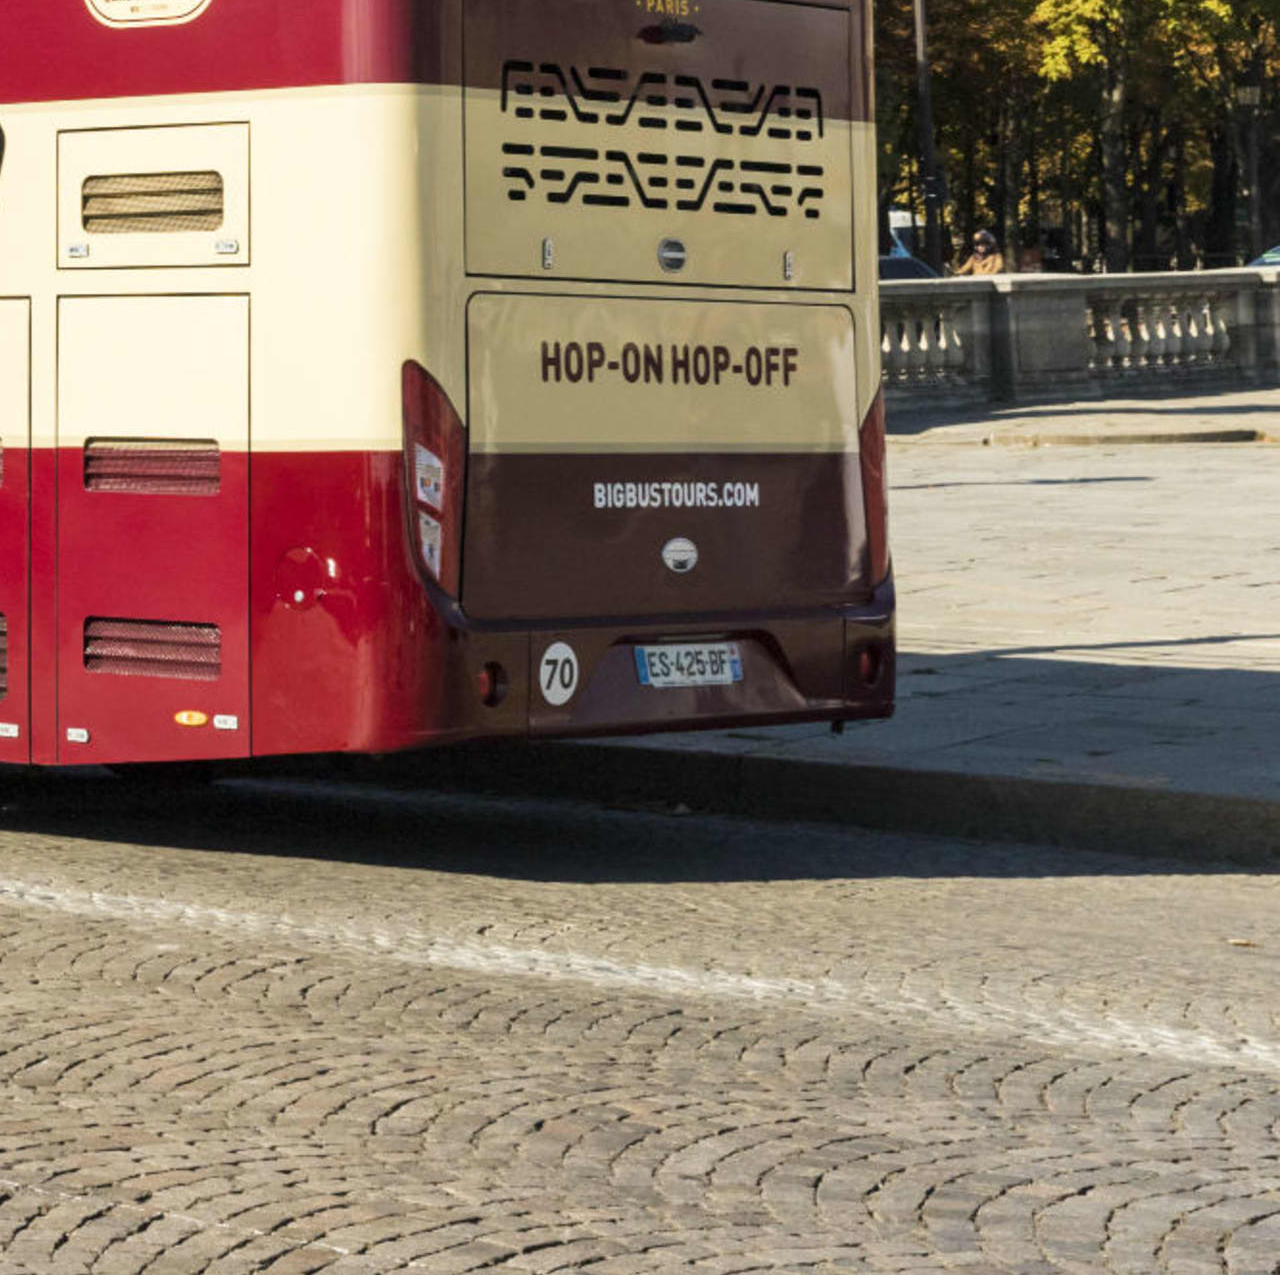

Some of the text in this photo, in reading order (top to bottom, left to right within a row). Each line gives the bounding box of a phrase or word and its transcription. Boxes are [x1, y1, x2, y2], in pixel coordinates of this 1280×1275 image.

[541, 341, 798, 386] HOP-ON HOP-OFF
[593, 482, 760, 508] BIGBUSTOURS.COM
[545, 658, 574, 690] 70
